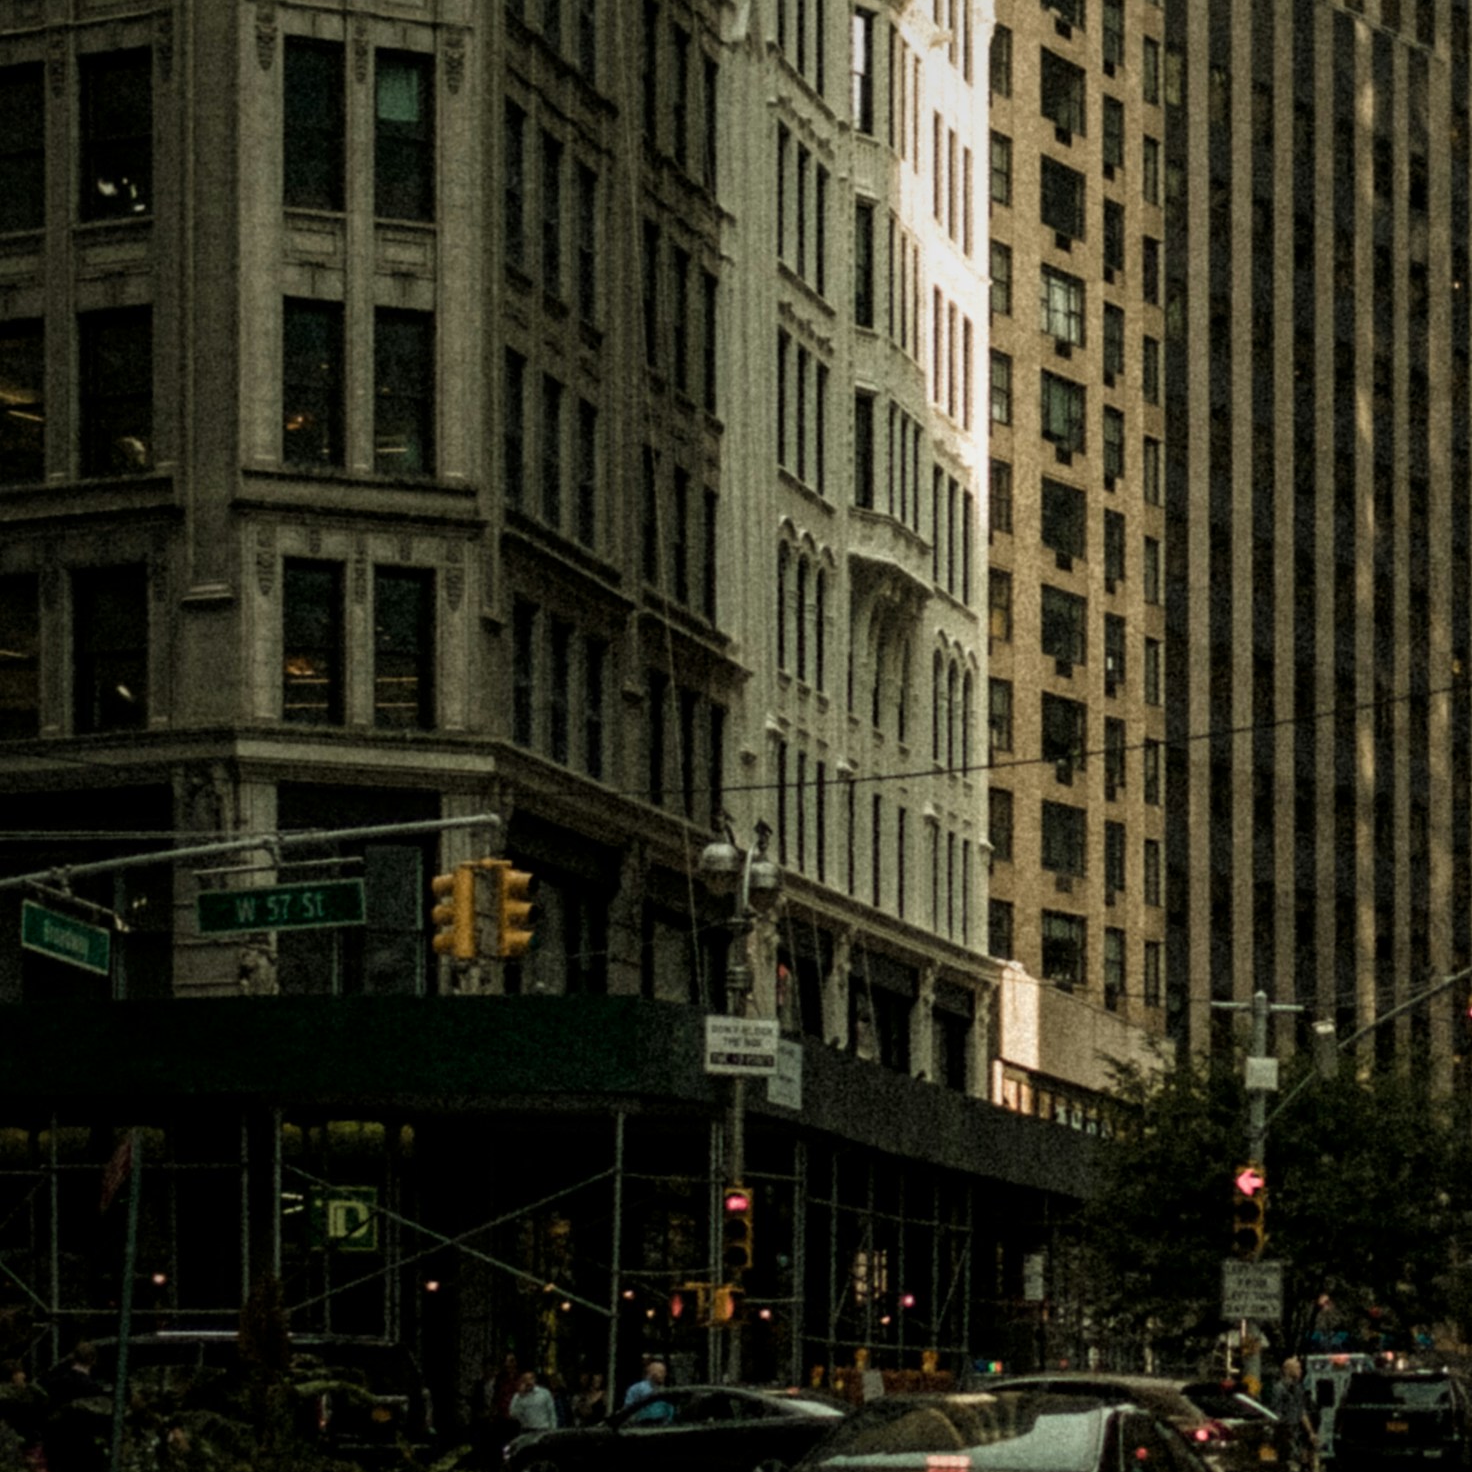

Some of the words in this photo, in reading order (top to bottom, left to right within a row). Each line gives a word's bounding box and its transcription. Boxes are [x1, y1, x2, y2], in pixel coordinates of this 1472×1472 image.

[234, 897, 256, 924] W
[266, 894, 292, 922] 57
[302, 891, 325, 918] St
